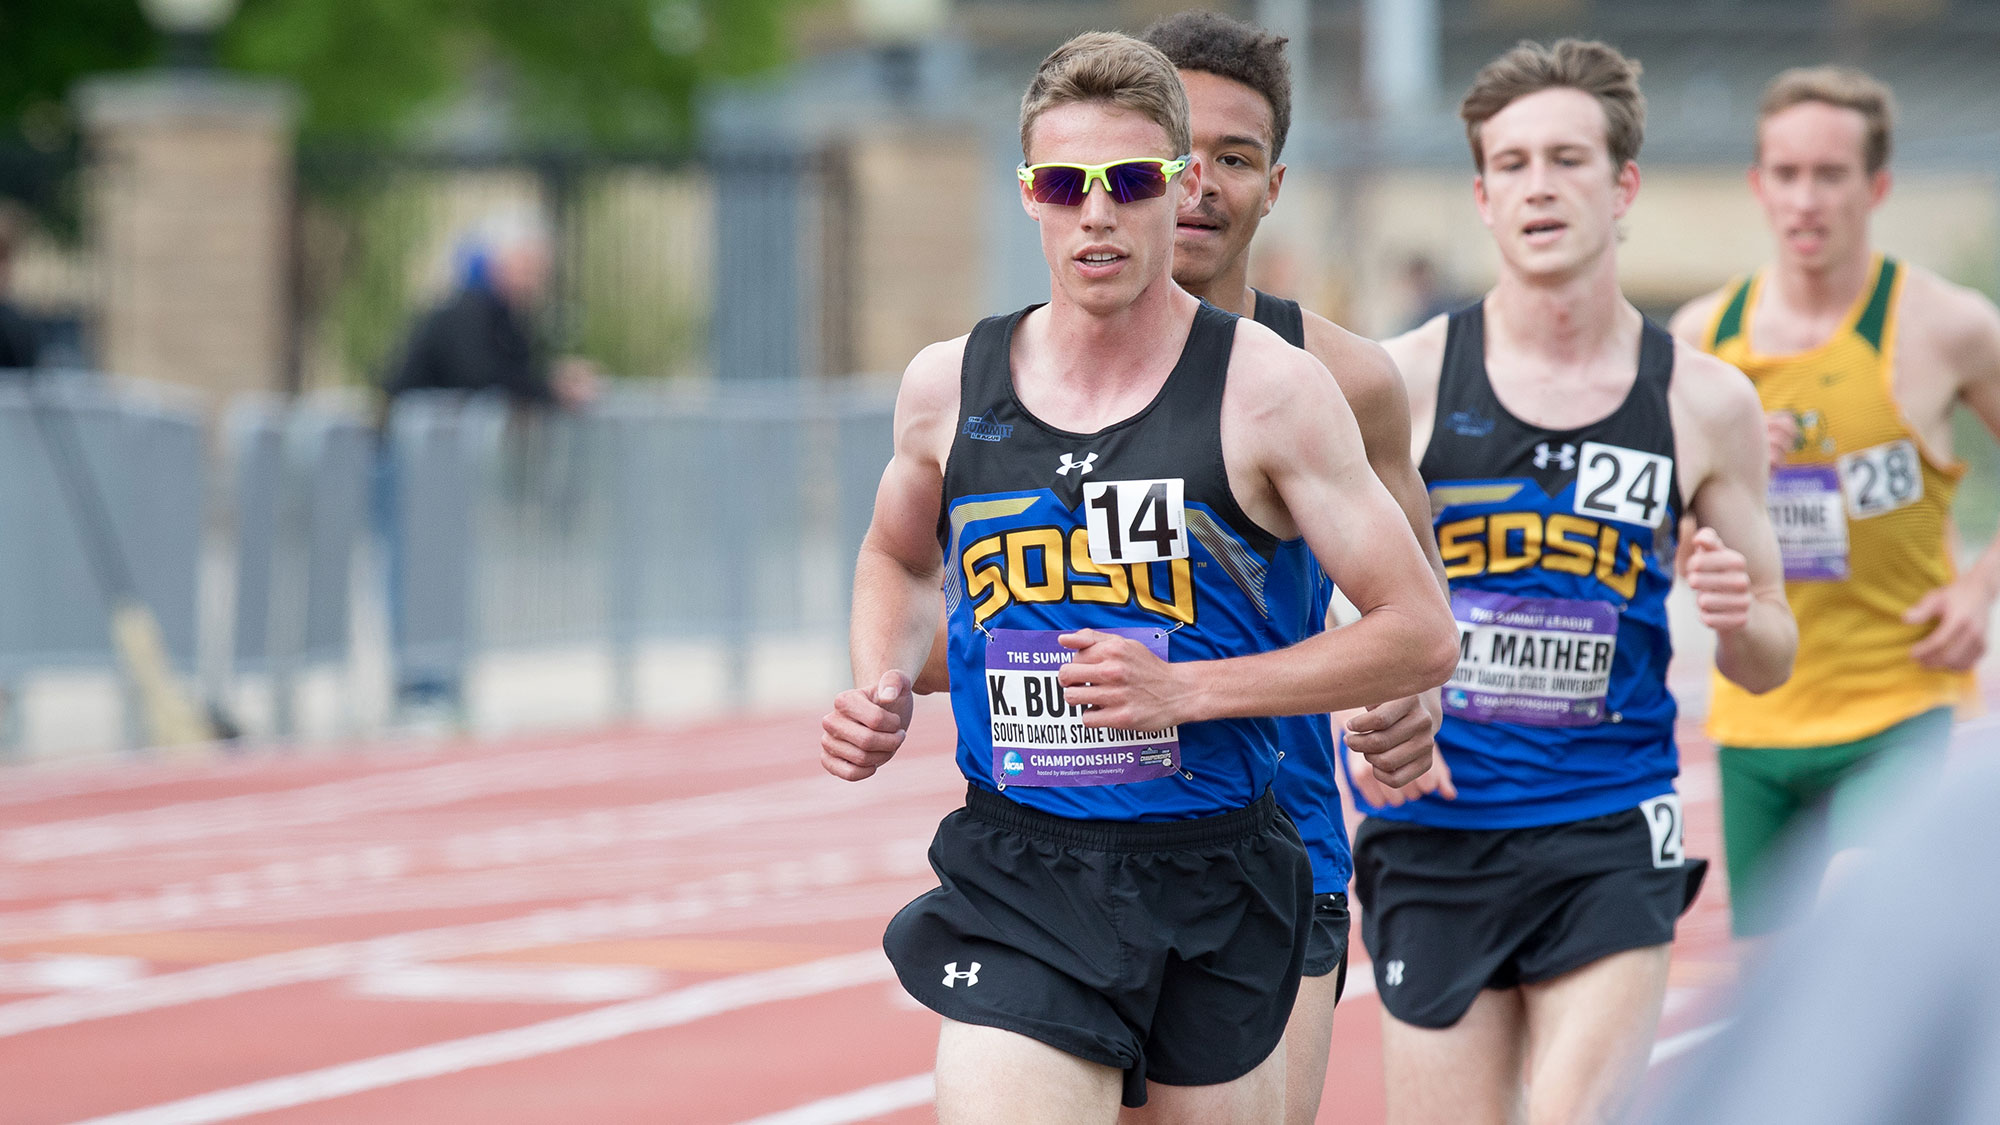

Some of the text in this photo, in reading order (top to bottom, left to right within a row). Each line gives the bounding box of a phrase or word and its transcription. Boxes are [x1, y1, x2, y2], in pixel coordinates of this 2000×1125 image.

[962, 421, 1013, 438] SUMMIT
[1583, 452, 1659, 521] 24
[1850, 446, 1914, 510] 28
[1091, 483, 1178, 560] 14
[1437, 511, 1646, 600] SDSU
[962, 525, 1197, 631] SDSU
[1495, 611, 1545, 627] SUMMIT
[1545, 614, 1595, 632] LEAGUE
[1007, 651, 1030, 663] THE
[1491, 633, 1611, 673] MATHER
[989, 675, 1088, 718] K. BU
[1472, 693, 1570, 713] CHAMPIONSHIPS
[993, 722, 1025, 742] SOUTH
[1027, 724, 1067, 744] DAKOTA
[1070, 724, 1104, 744] STATE
[1030, 752, 1135, 767] CHAMPIONSHIPS
[1655, 803, 1682, 861] 2
